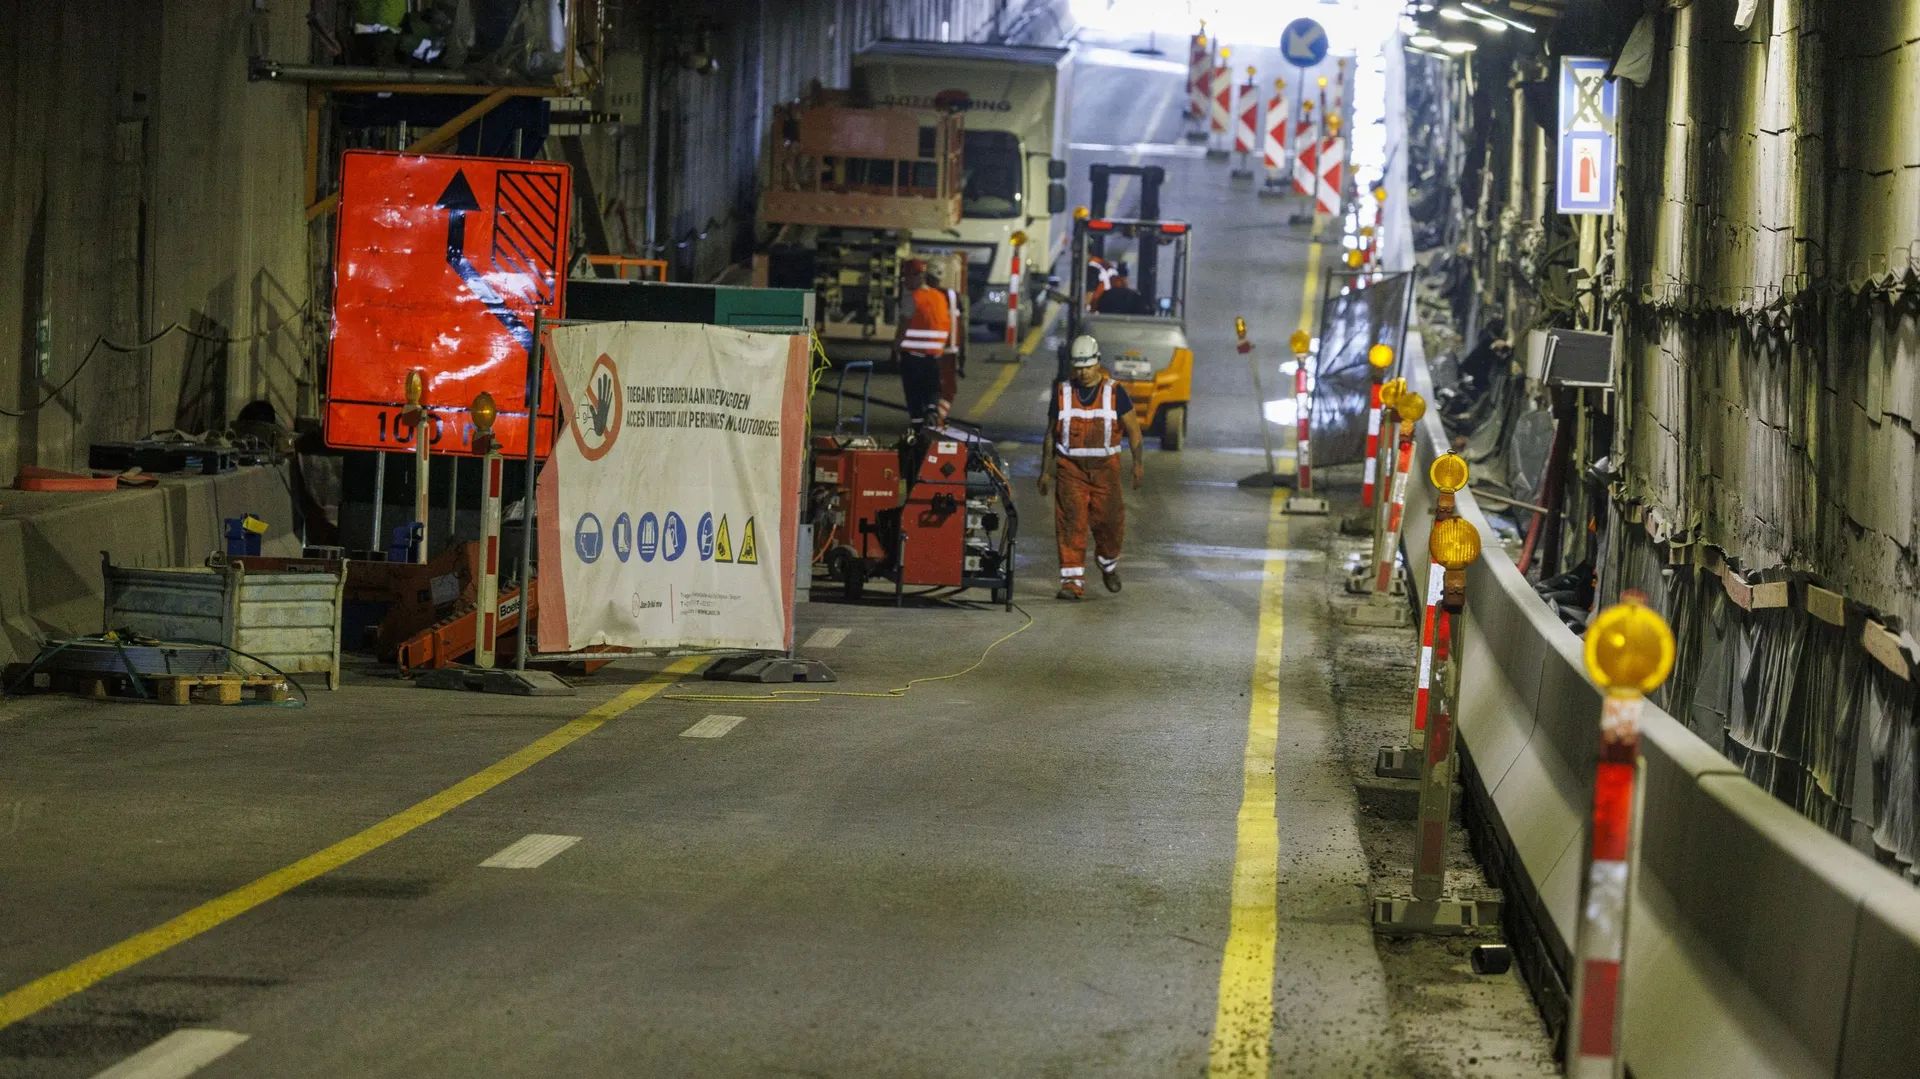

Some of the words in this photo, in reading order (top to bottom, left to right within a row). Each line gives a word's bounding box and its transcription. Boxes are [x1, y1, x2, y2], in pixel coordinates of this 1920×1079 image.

[626, 386, 656, 404] TOEGANG
[688, 387, 706, 405] AAN
[647, 410, 676, 428] INTERDIT
